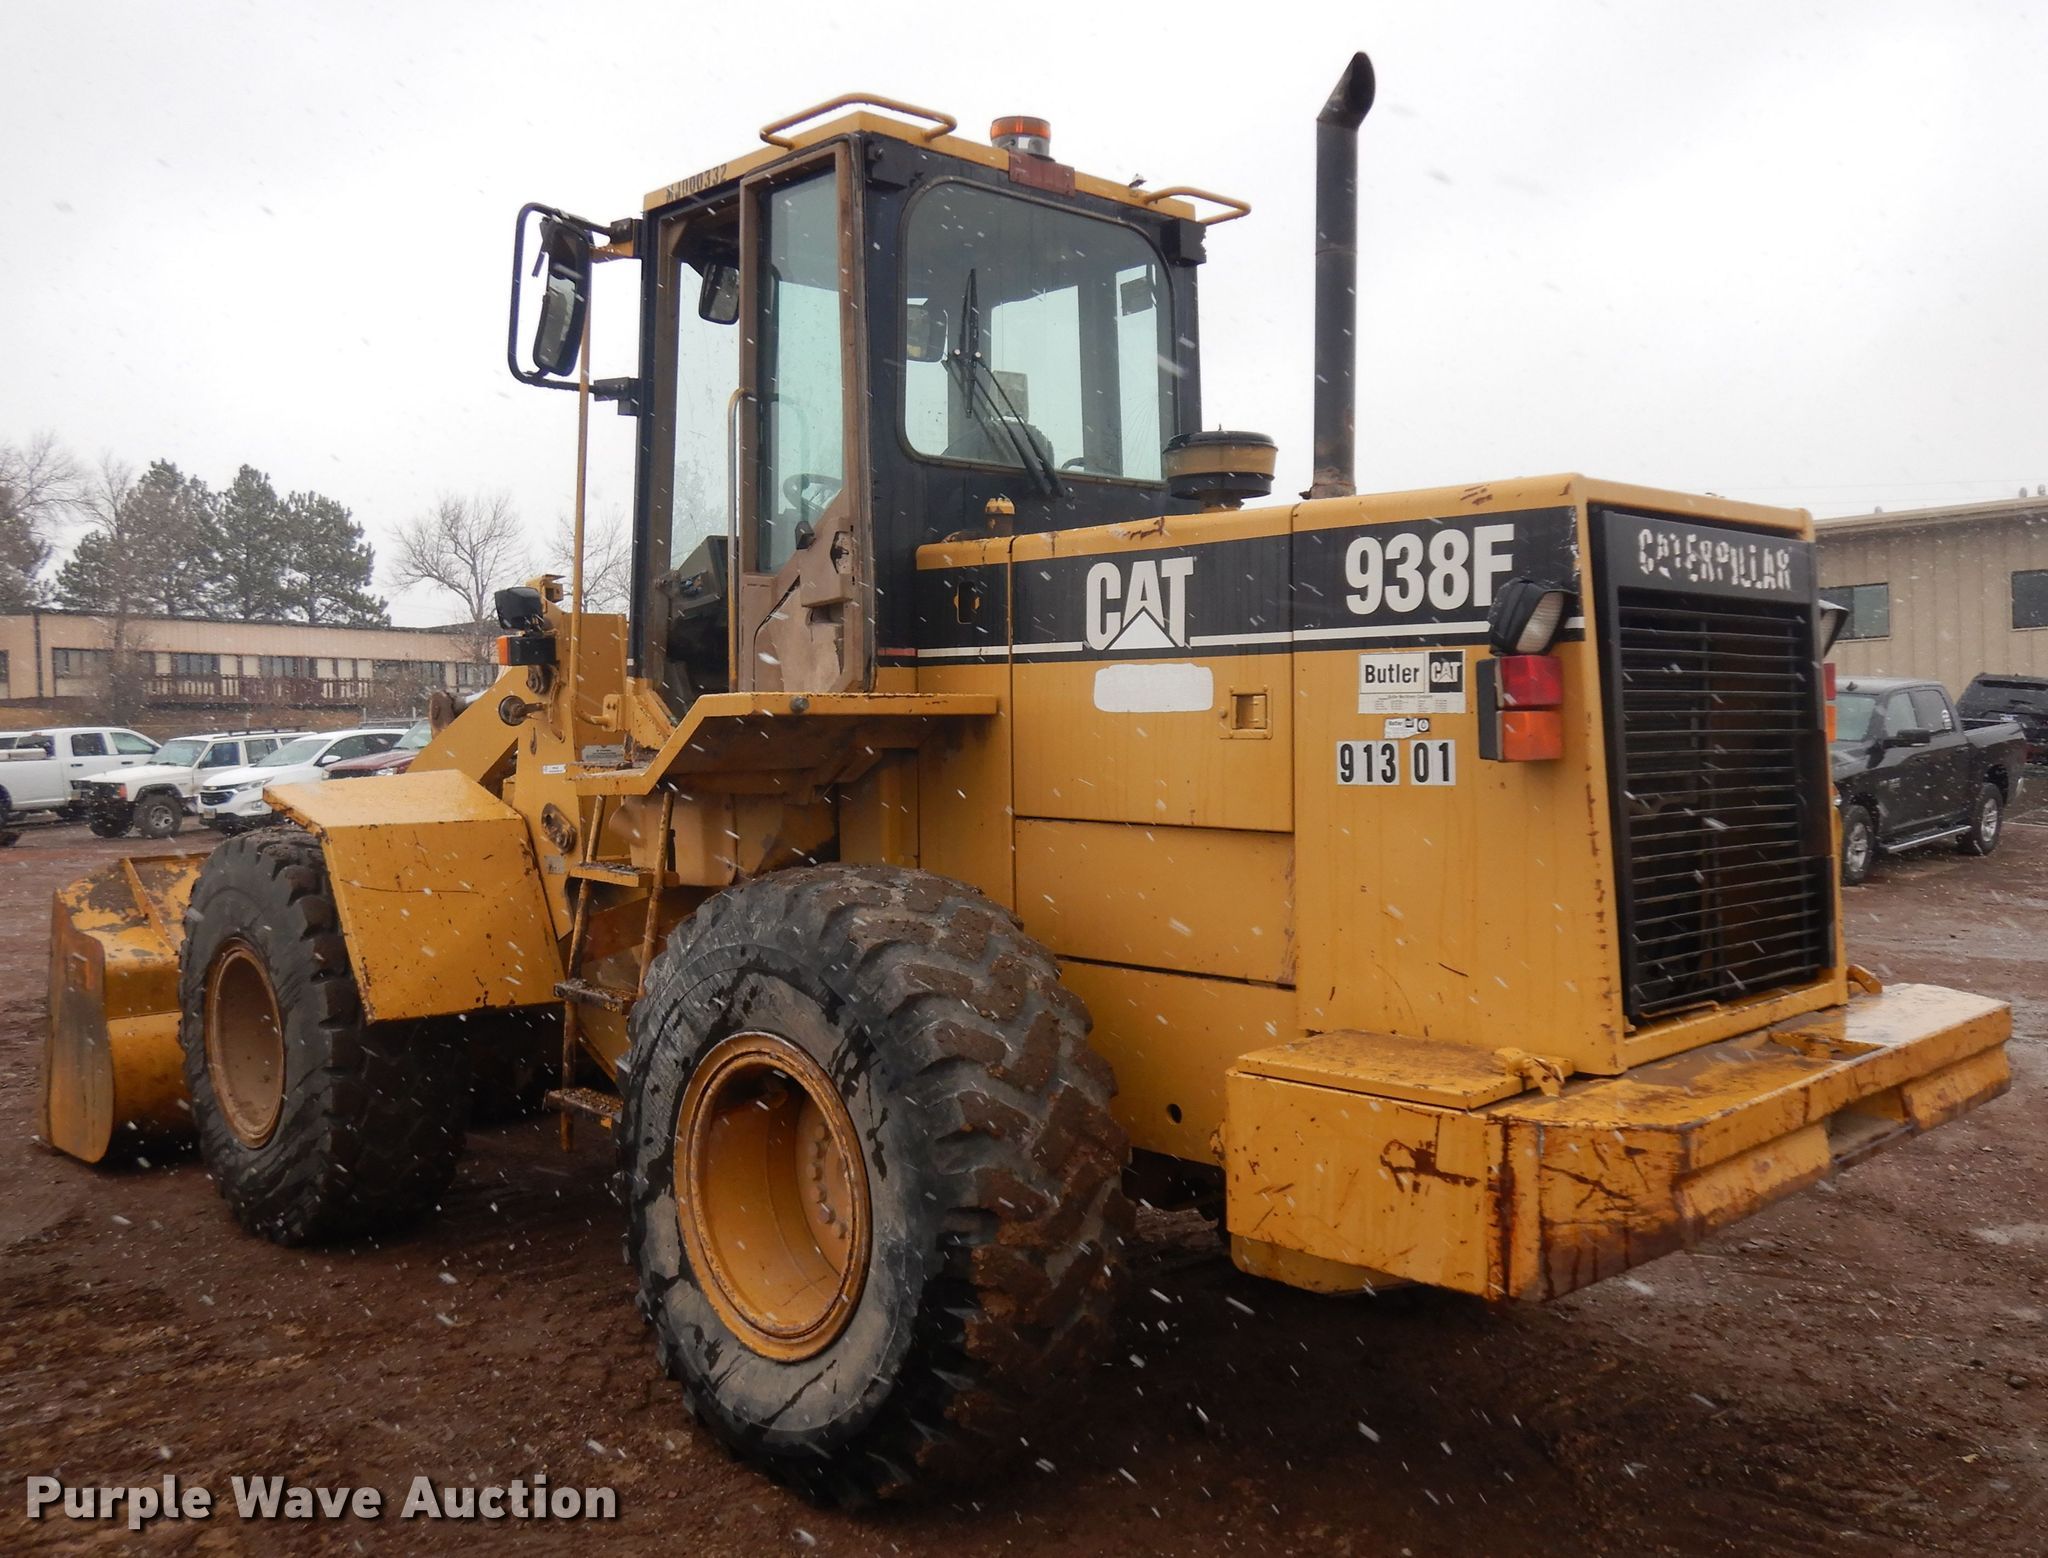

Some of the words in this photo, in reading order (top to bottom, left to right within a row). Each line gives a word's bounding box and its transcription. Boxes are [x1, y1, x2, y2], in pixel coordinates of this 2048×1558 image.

[1345, 523, 1515, 615] 938F
[1086, 556, 1194, 651] CAT
[1365, 664, 1420, 684] Butler
[1431, 661, 1462, 683] CAT
[1340, 743, 1396, 783] 913
[1414, 742, 1450, 783] 01
